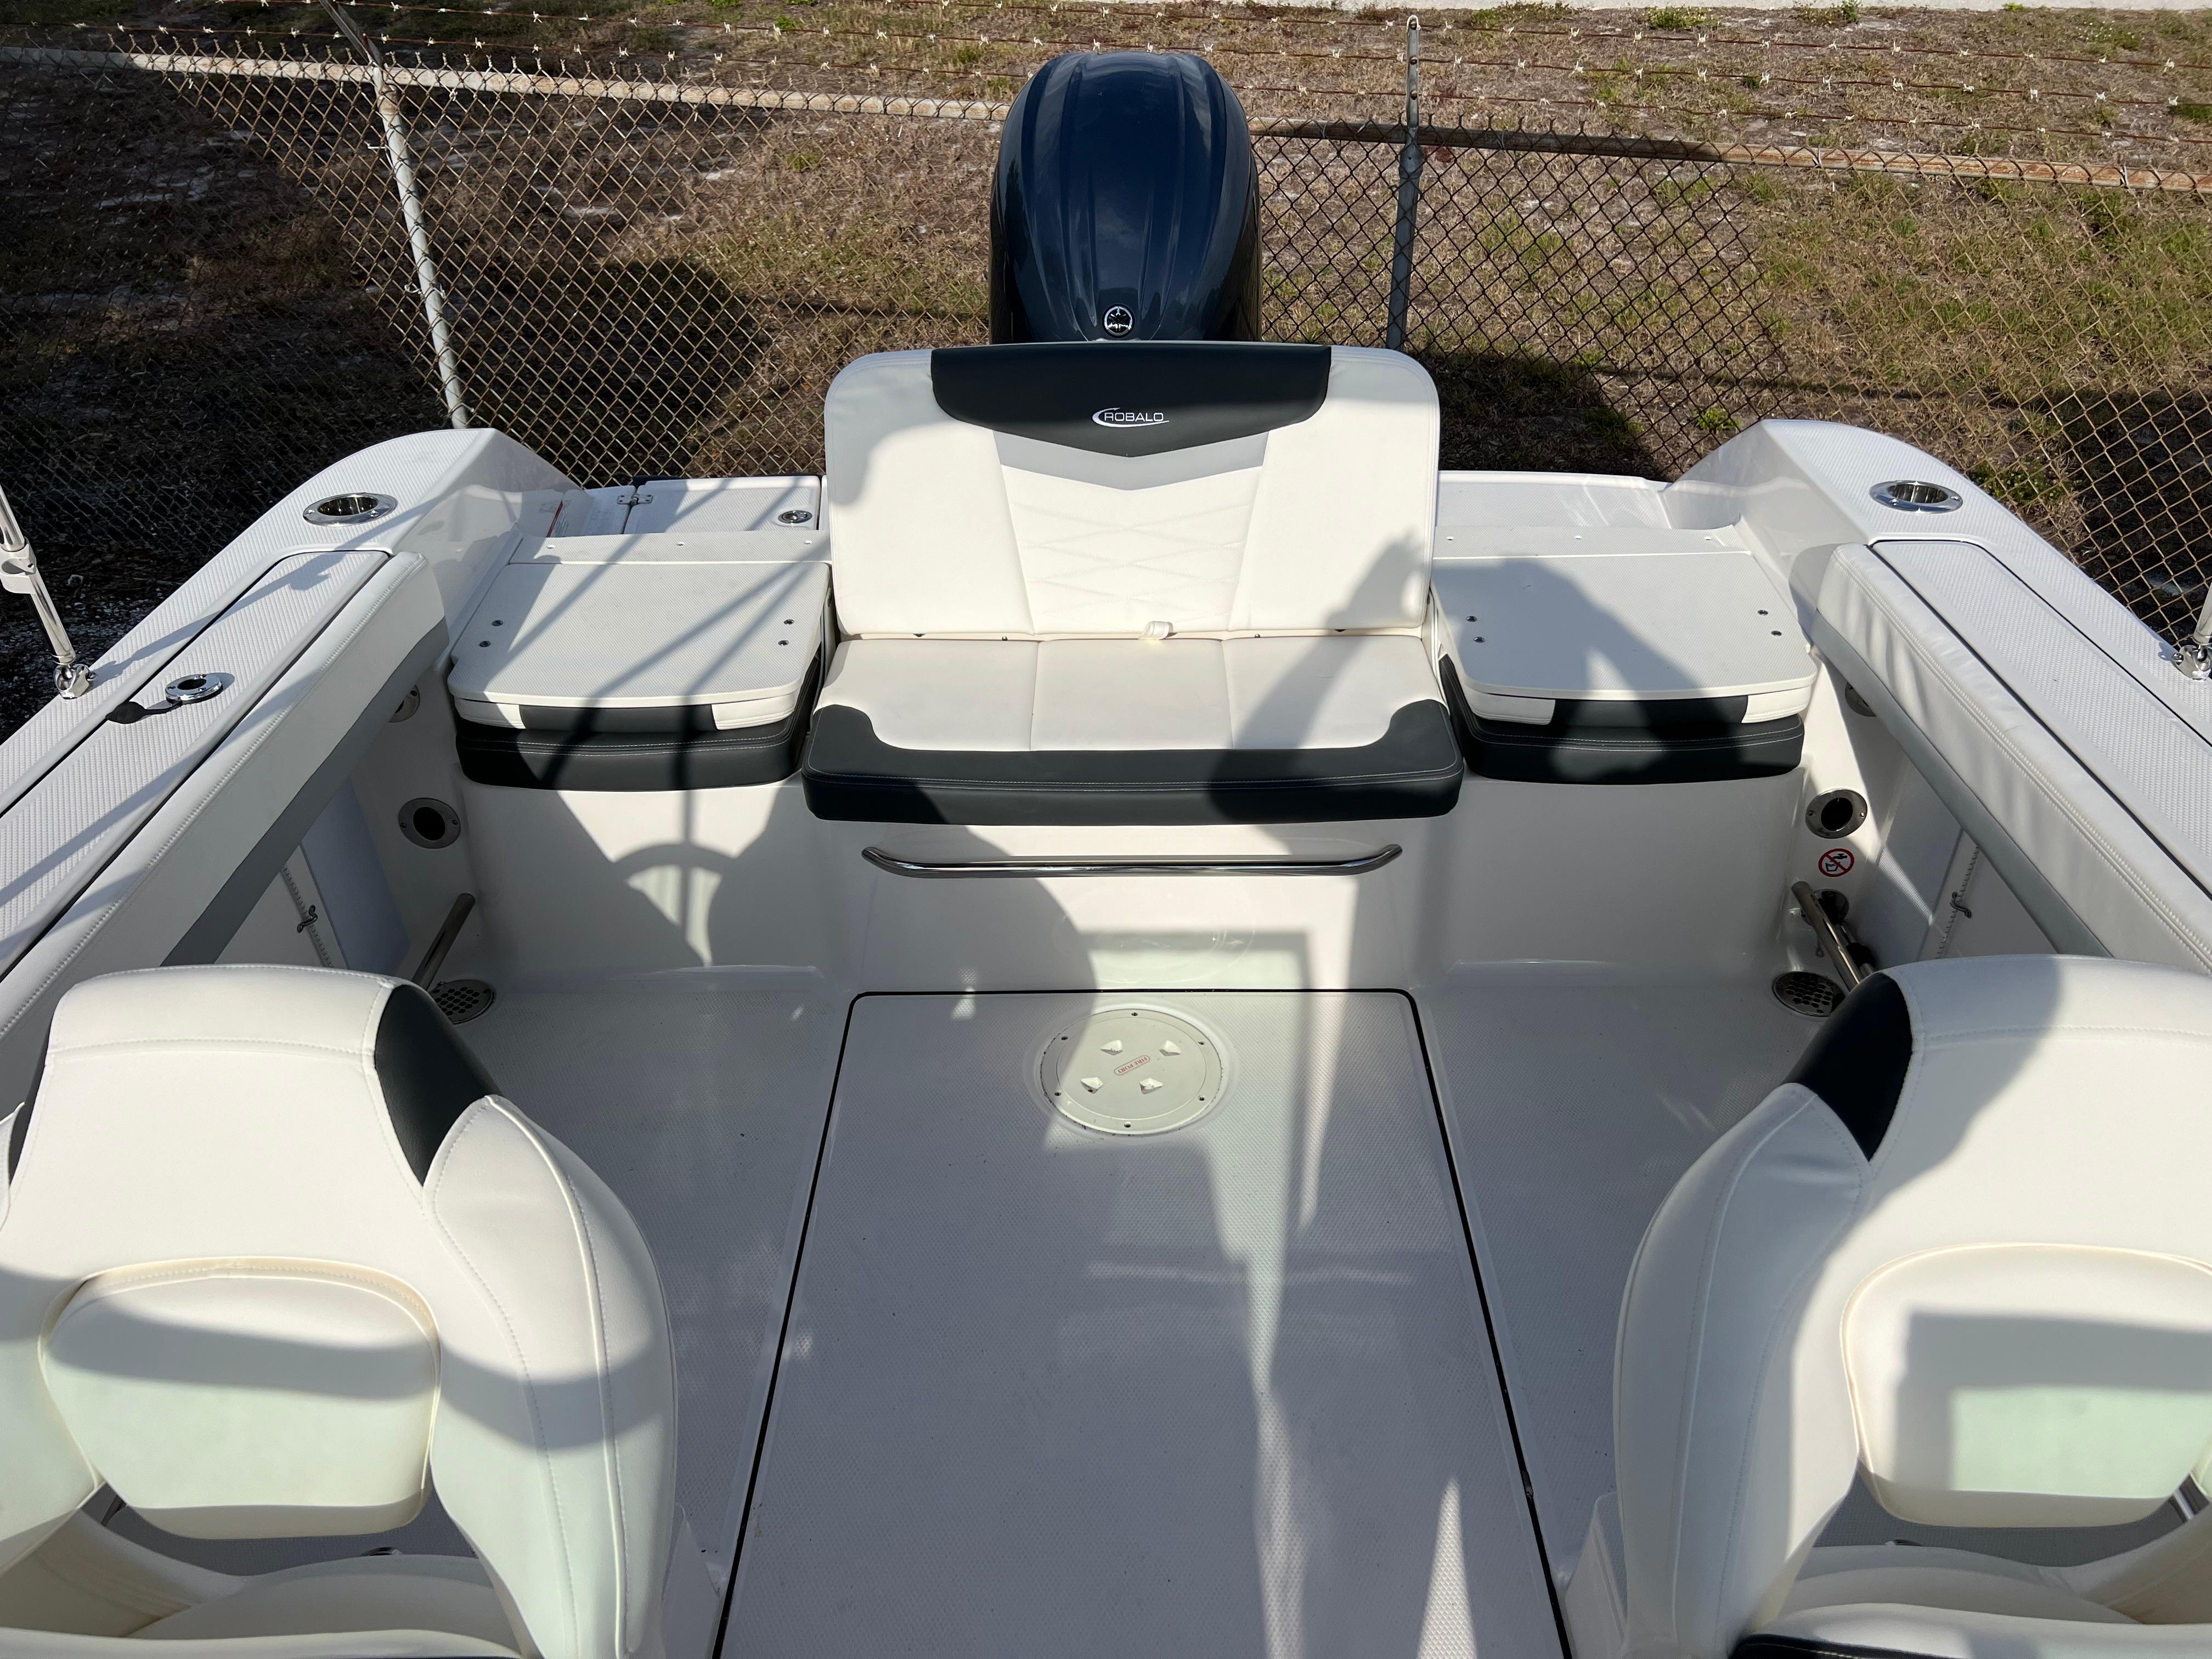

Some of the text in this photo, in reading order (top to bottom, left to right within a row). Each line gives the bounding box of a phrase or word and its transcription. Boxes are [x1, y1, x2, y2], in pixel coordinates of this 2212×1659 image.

[1104, 412, 1164, 422] ROBALO
[1117, 1057, 1148, 1074] FIRE PORT
